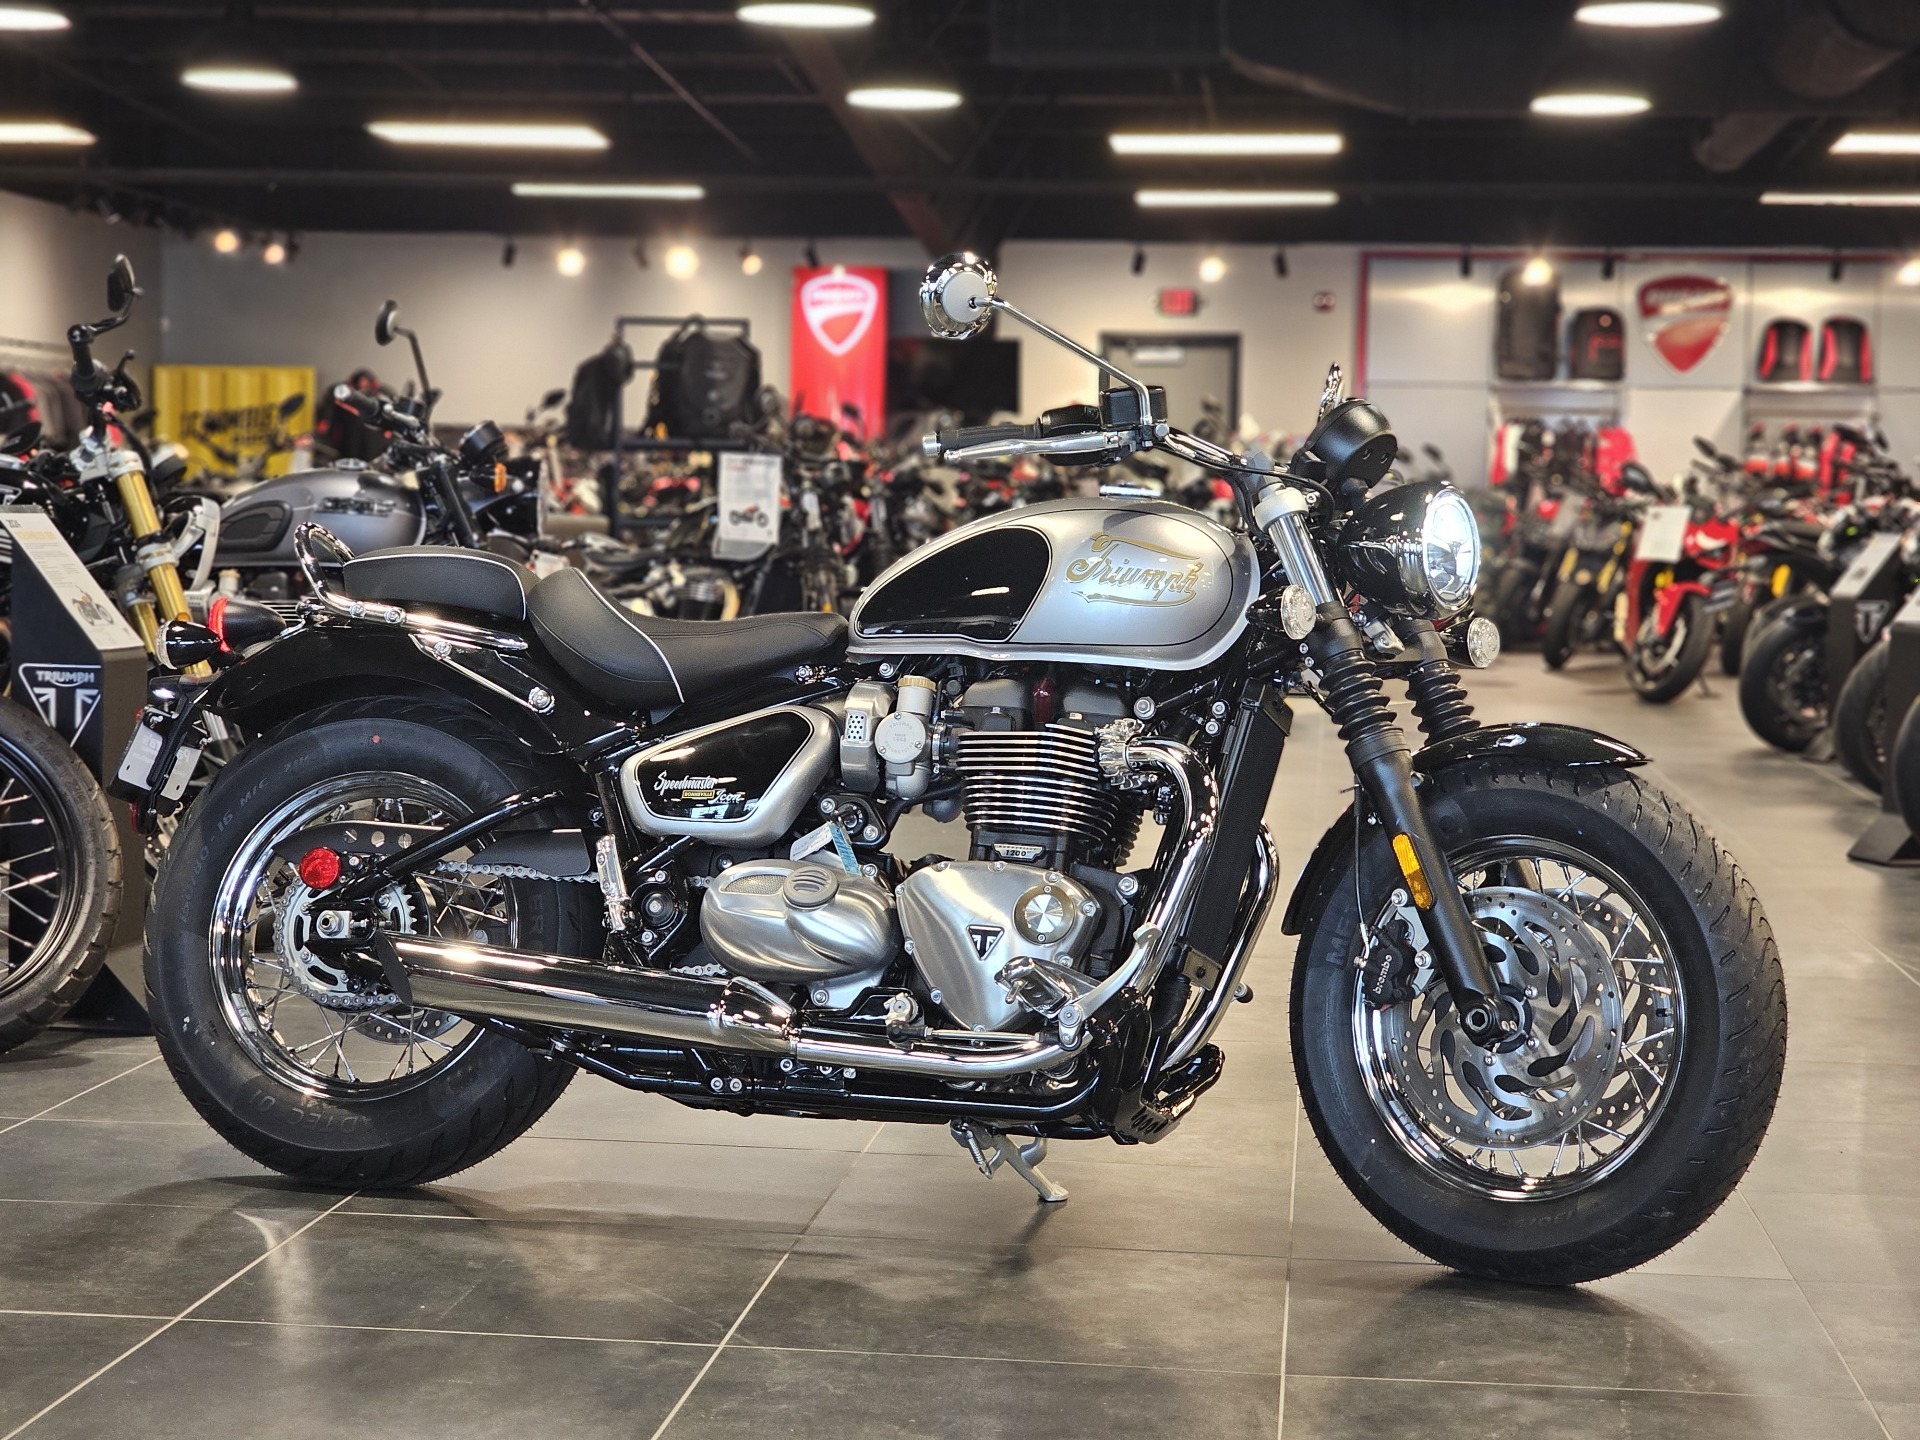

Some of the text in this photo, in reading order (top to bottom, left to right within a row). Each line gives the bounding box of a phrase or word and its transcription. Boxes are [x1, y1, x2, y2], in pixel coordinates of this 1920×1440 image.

[1066, 532, 1204, 606] Triumph
[35, 670, 95, 683] TRIUMPH
[653, 770, 718, 796] Speedmaster
[708, 788, 745, 804] Icon
[1372, 954, 1392, 995] brembo
